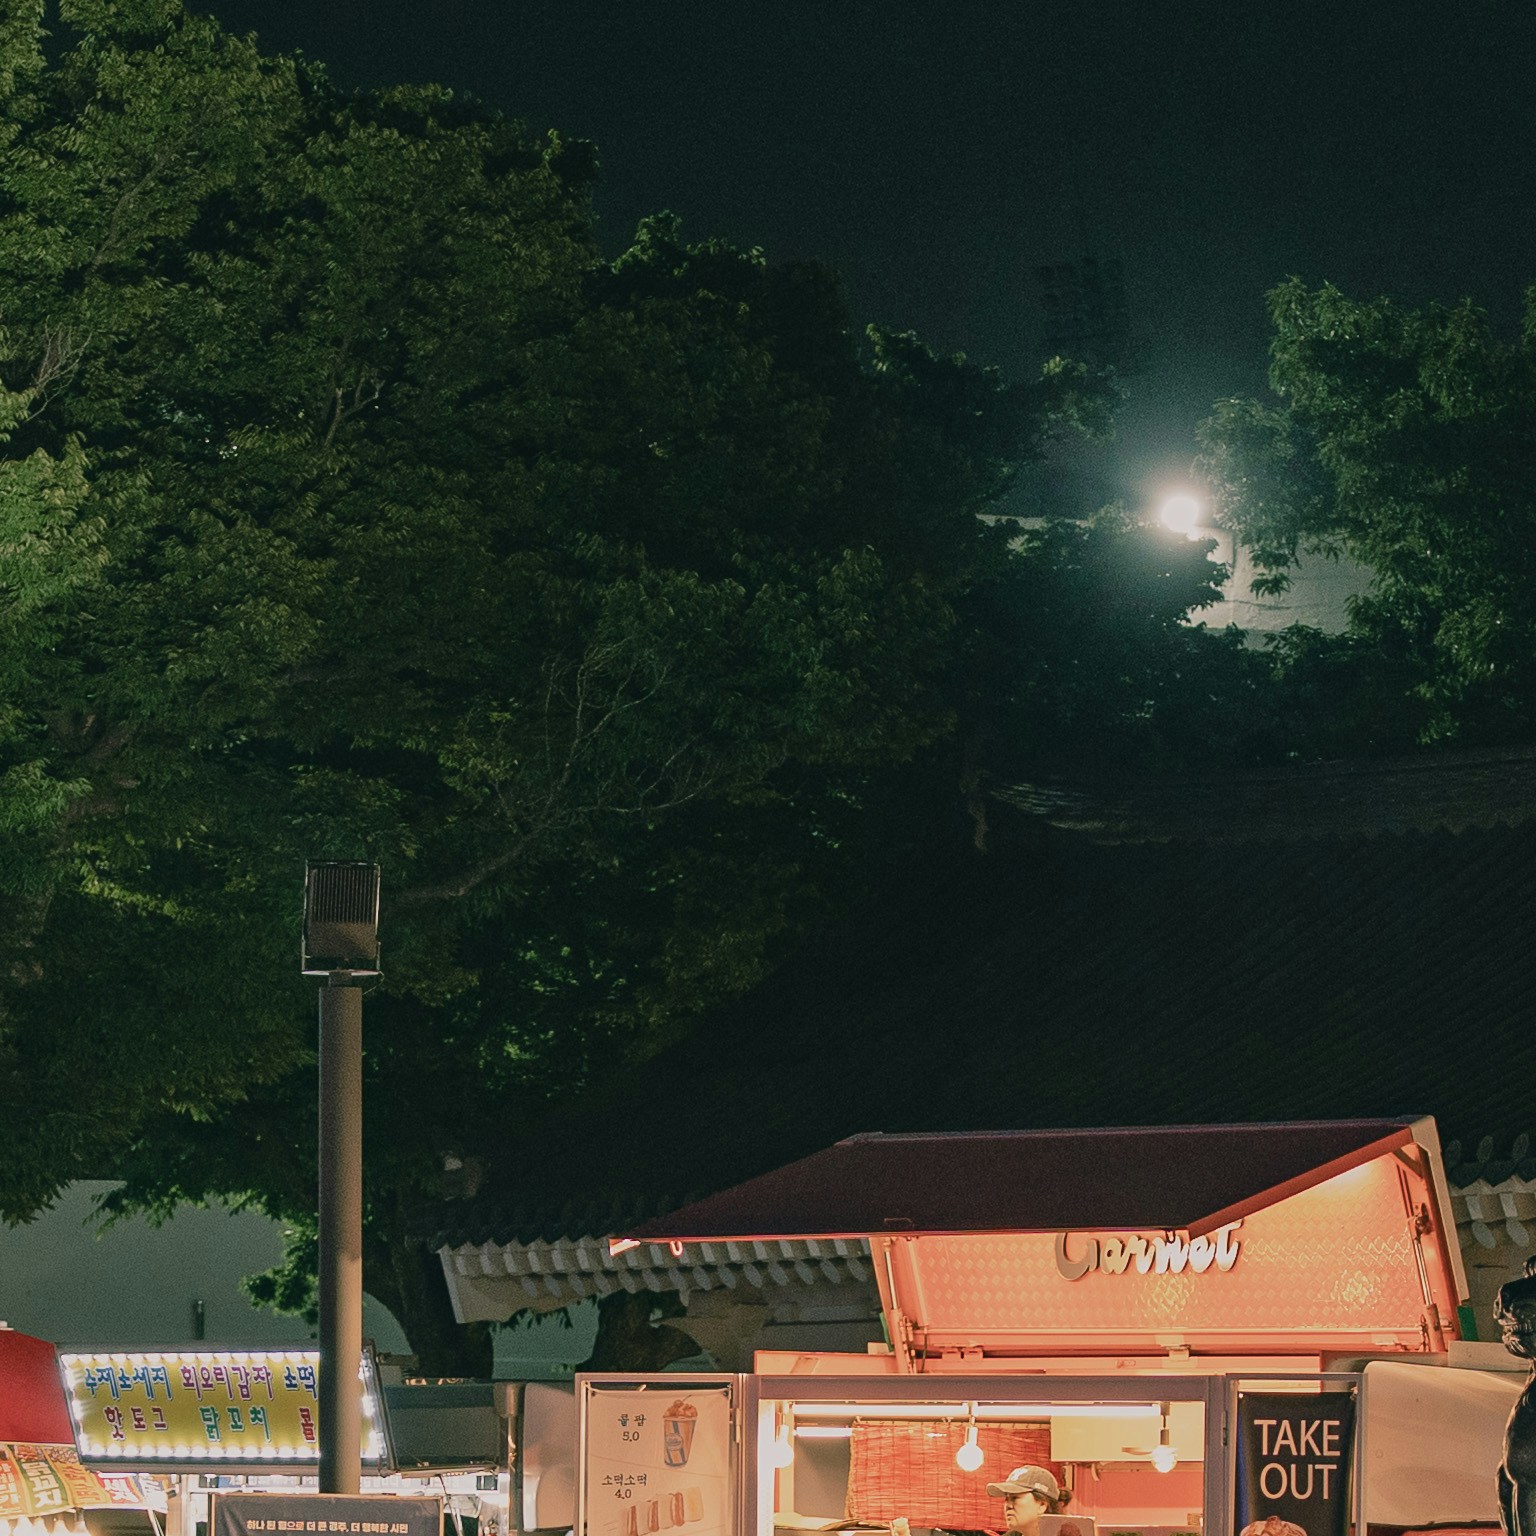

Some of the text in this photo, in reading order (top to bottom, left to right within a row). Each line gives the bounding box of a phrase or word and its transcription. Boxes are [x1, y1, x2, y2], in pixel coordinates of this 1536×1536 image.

[85, 1364, 174, 1401] 수제소세지
[179, 1364, 273, 1401] 회오리감자
[1254, 1419, 1341, 1456] TAKE
[1260, 1463, 1338, 1500] OUT
